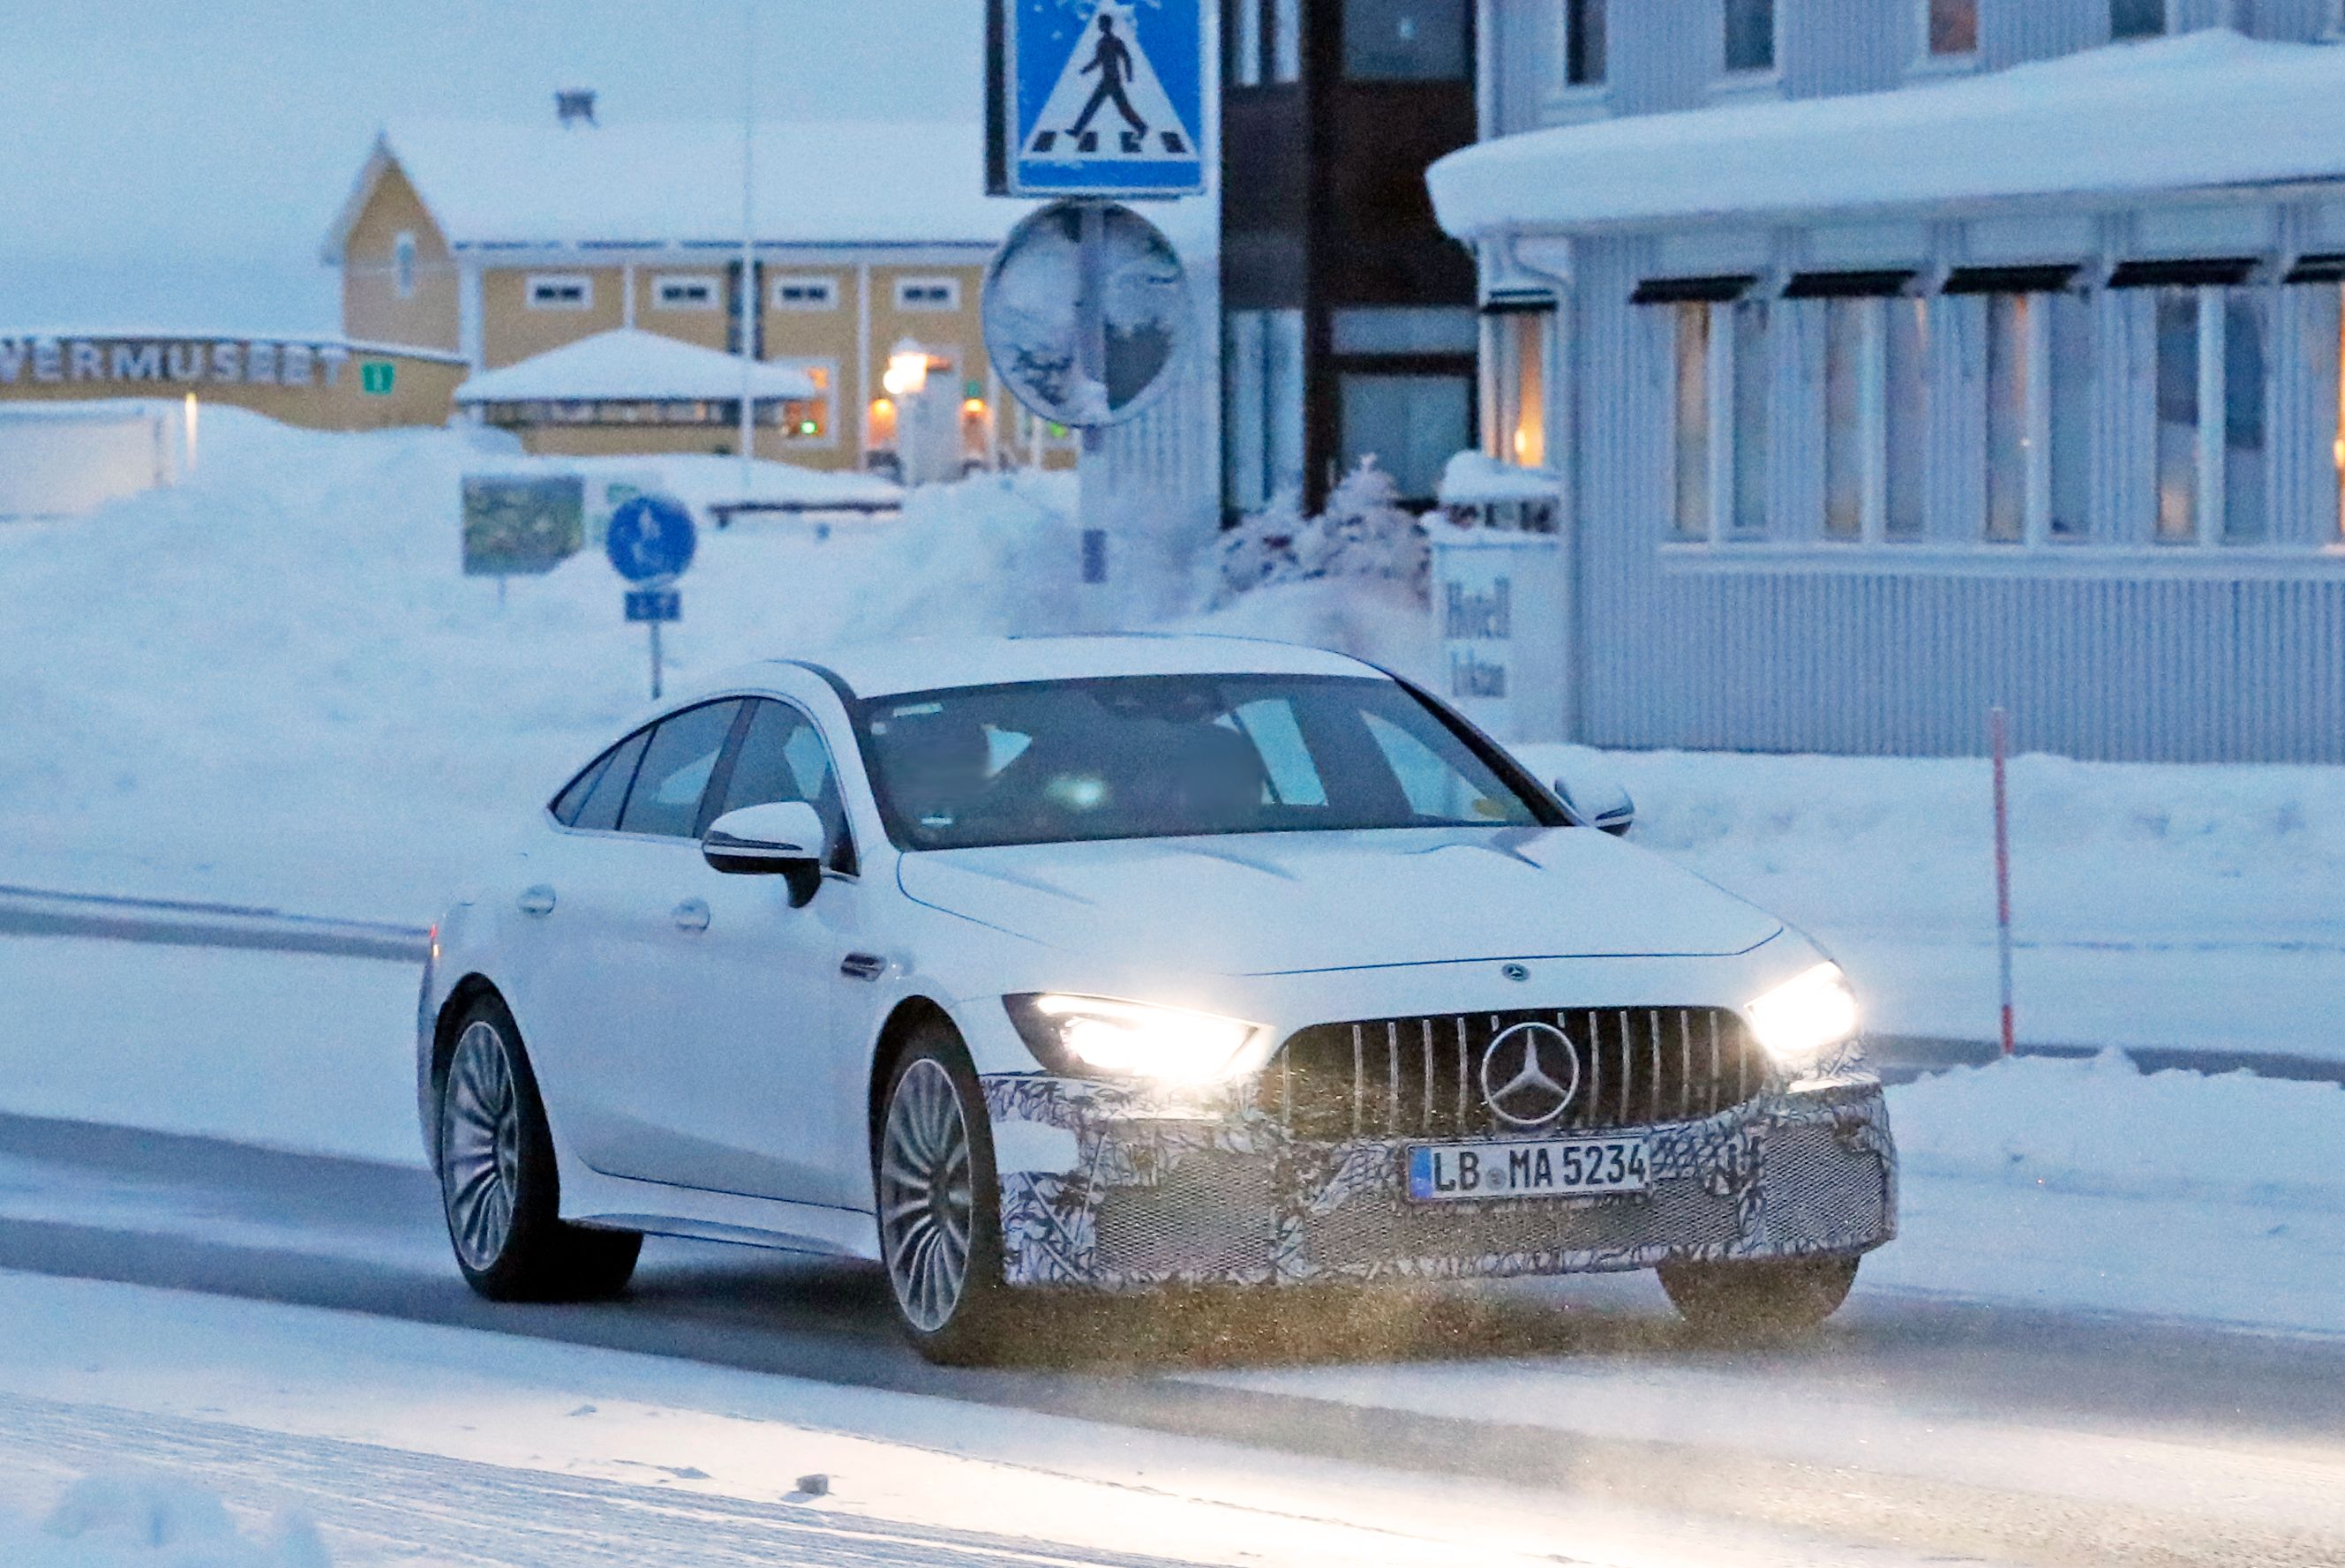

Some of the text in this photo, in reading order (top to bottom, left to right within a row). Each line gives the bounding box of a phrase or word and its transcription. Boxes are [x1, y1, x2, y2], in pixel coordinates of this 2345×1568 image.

[1434, 1144, 1646, 1191] LB MA 5234
